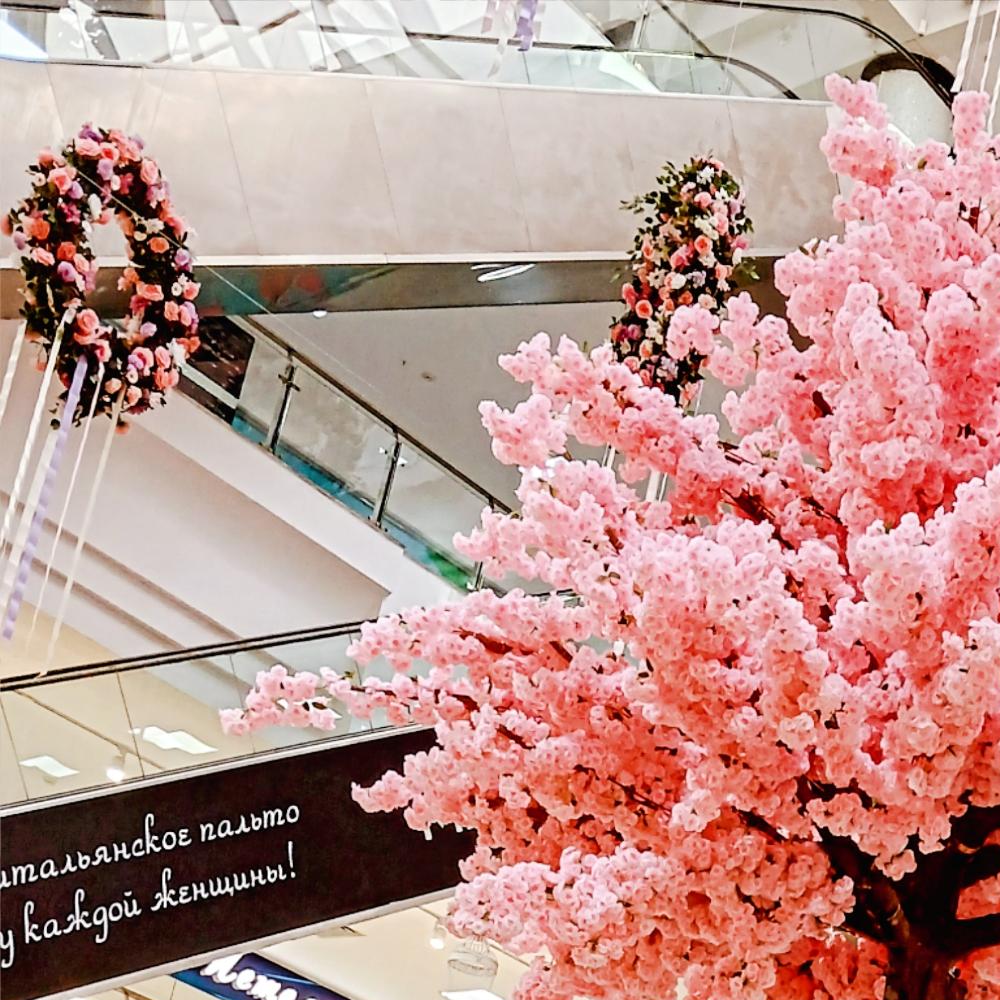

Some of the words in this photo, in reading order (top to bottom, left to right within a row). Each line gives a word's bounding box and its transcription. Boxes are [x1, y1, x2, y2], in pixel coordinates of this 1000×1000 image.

[200, 804, 300, 842] пальто
[24, 888, 142, 944] каждой
[151, 840, 297, 912] женщины!
